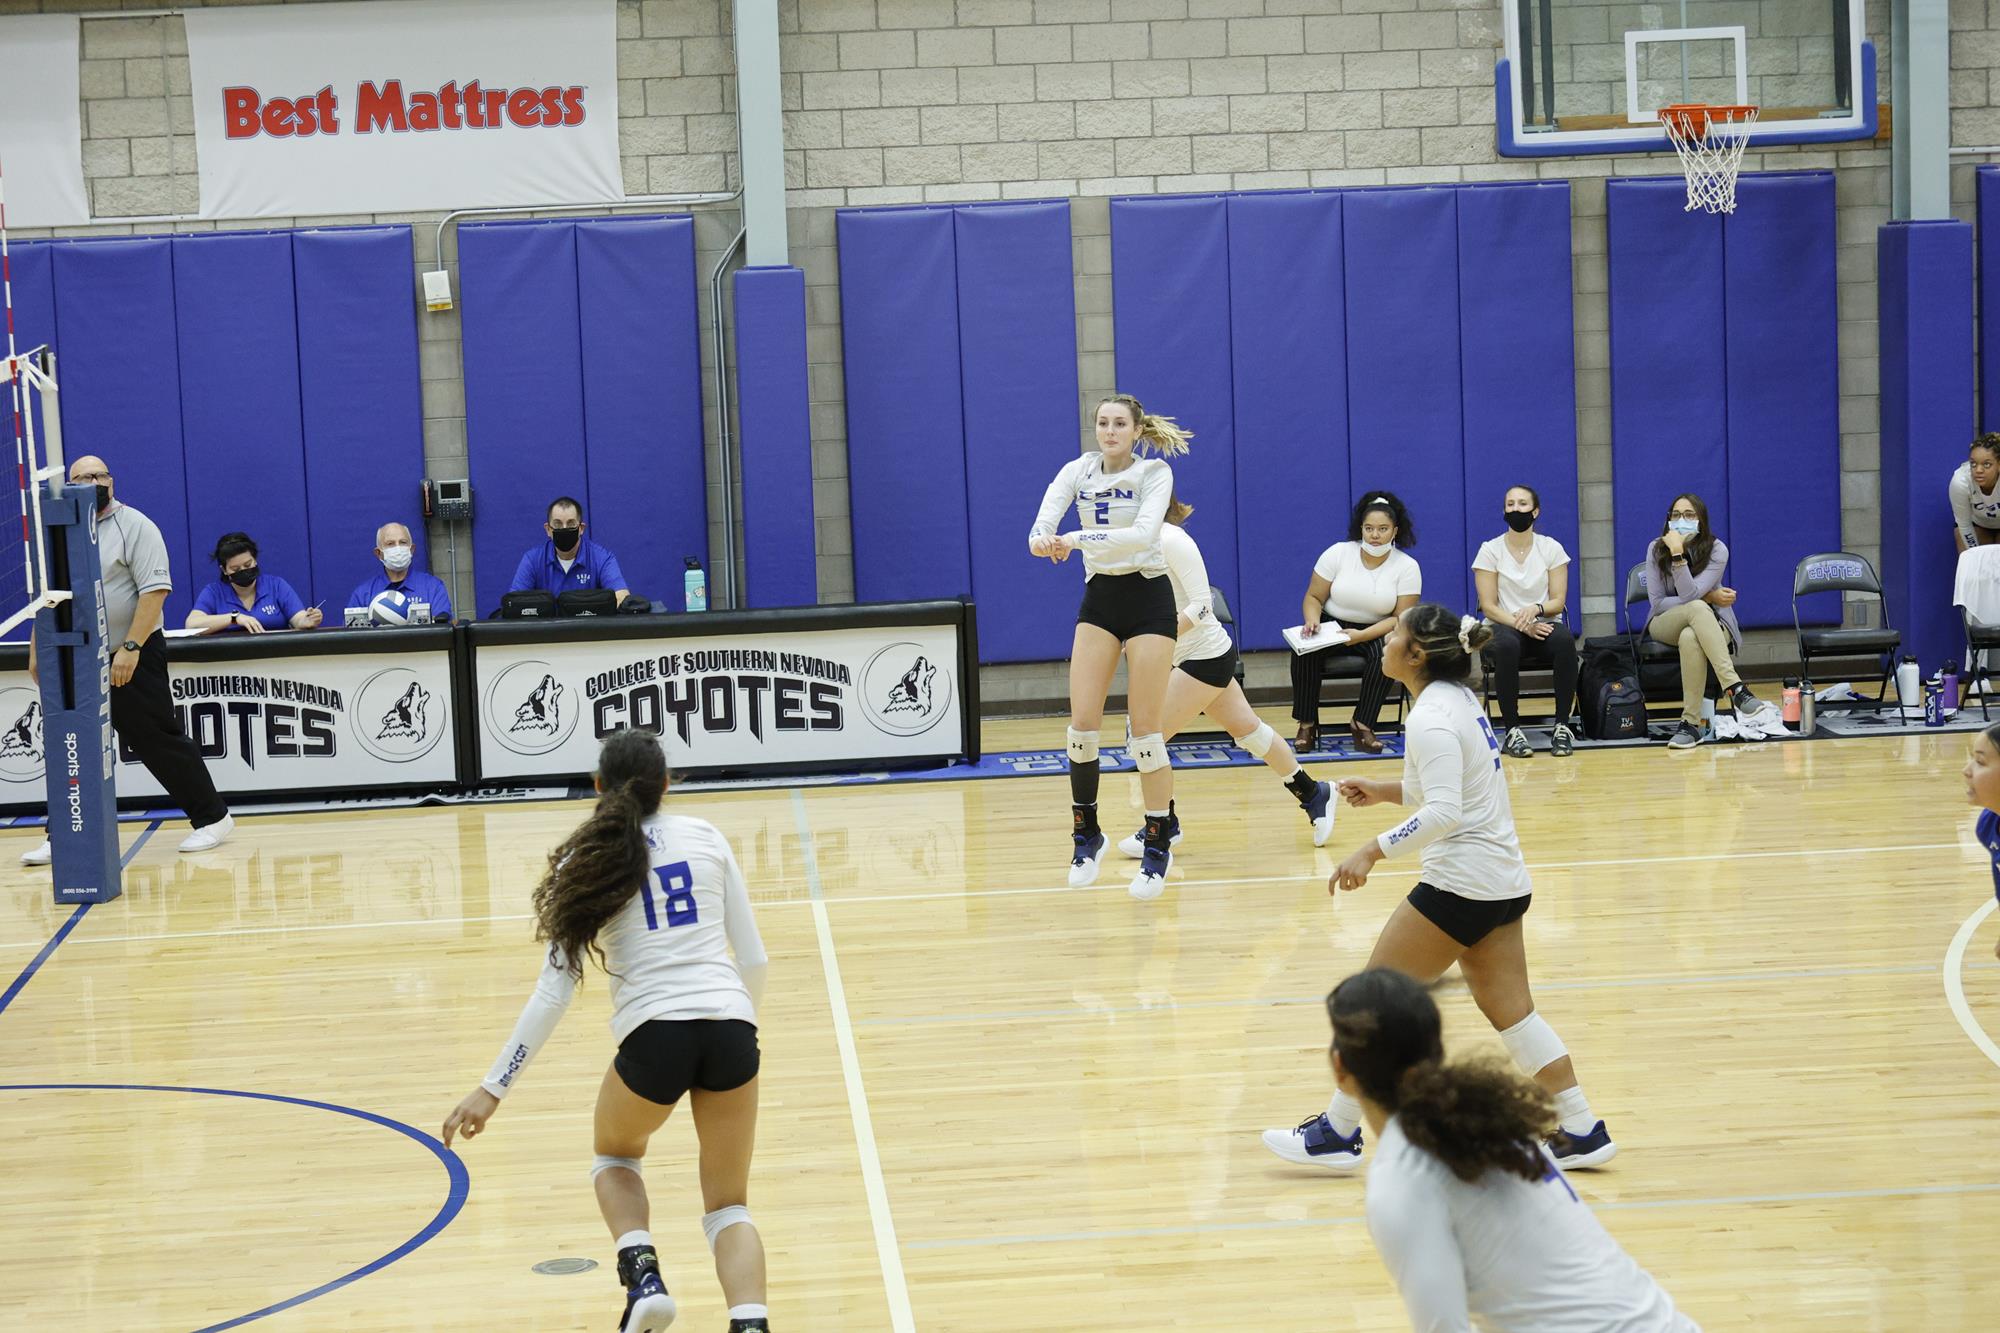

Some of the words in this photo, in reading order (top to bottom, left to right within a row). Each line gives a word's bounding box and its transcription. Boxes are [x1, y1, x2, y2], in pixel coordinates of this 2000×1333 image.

[222, 85, 340, 140] Best
[354, 79, 586, 134] Mattress
[172, 676, 268, 698] SOUTHERN
[271, 678, 344, 712] NEVADA
[585, 659, 656, 699] COLLEGE
[658, 654, 681, 677] OF
[683, 650, 777, 673] SOUTHERN
[780, 652, 852, 686] NEVADA
[593, 675, 844, 748] COYOTES
[64, 732, 79, 777] sports
[641, 861, 698, 931] 18
